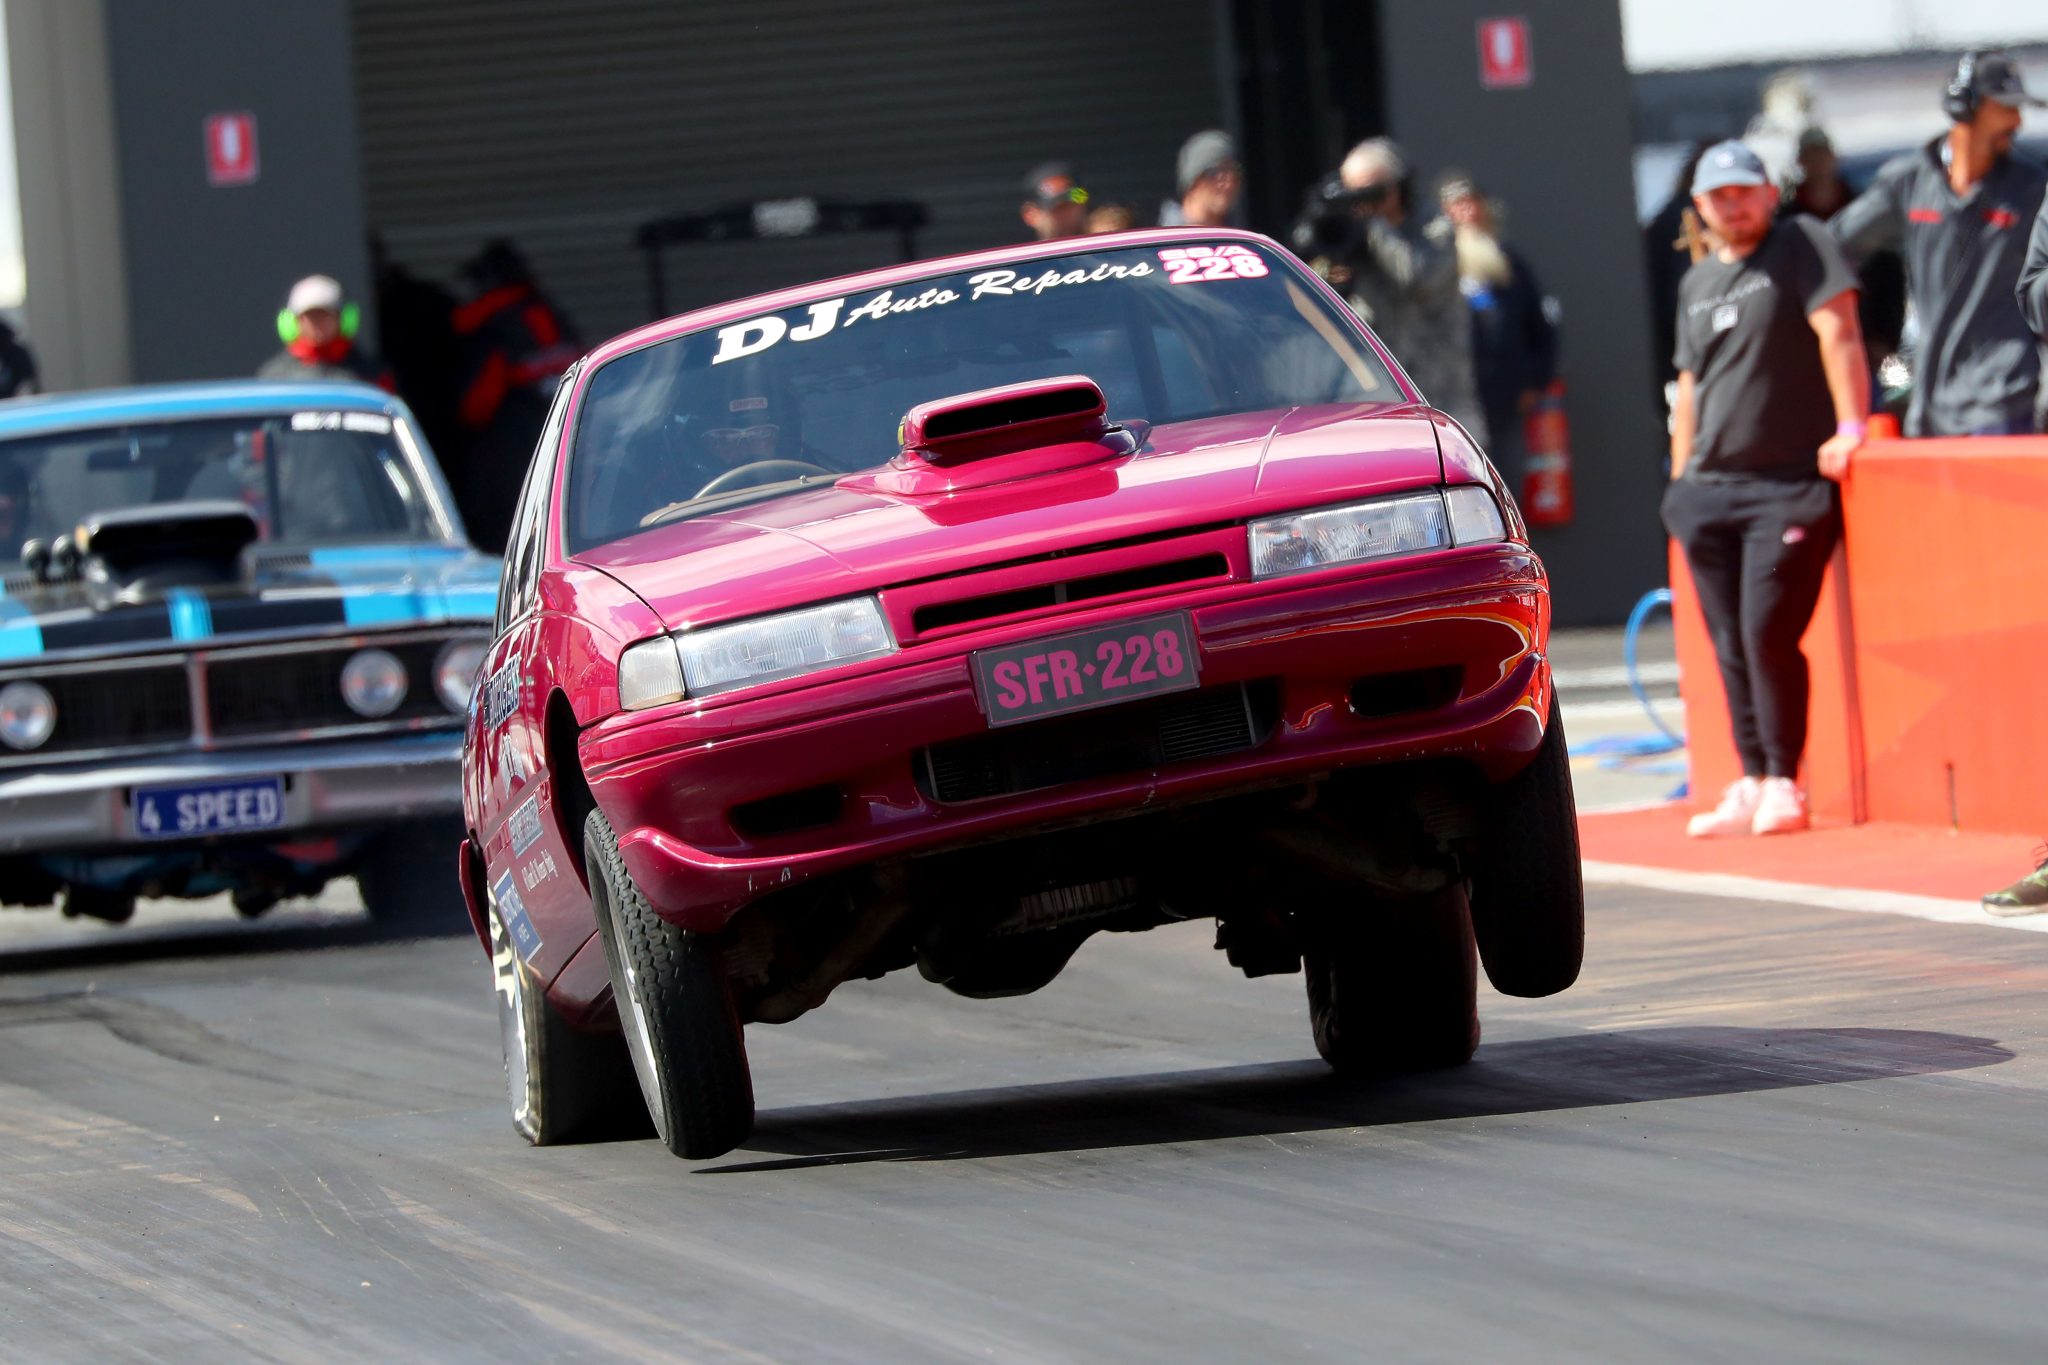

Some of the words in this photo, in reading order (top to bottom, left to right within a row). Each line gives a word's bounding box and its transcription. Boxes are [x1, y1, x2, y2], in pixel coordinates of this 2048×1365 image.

[1164, 255, 1269, 284] 228
[712, 298, 845, 365] DJ
[844, 288, 960, 328] Auto
[969, 261, 1154, 300] Repairs
[141, 796, 162, 832] 4
[176, 787, 278, 831] SPEED
